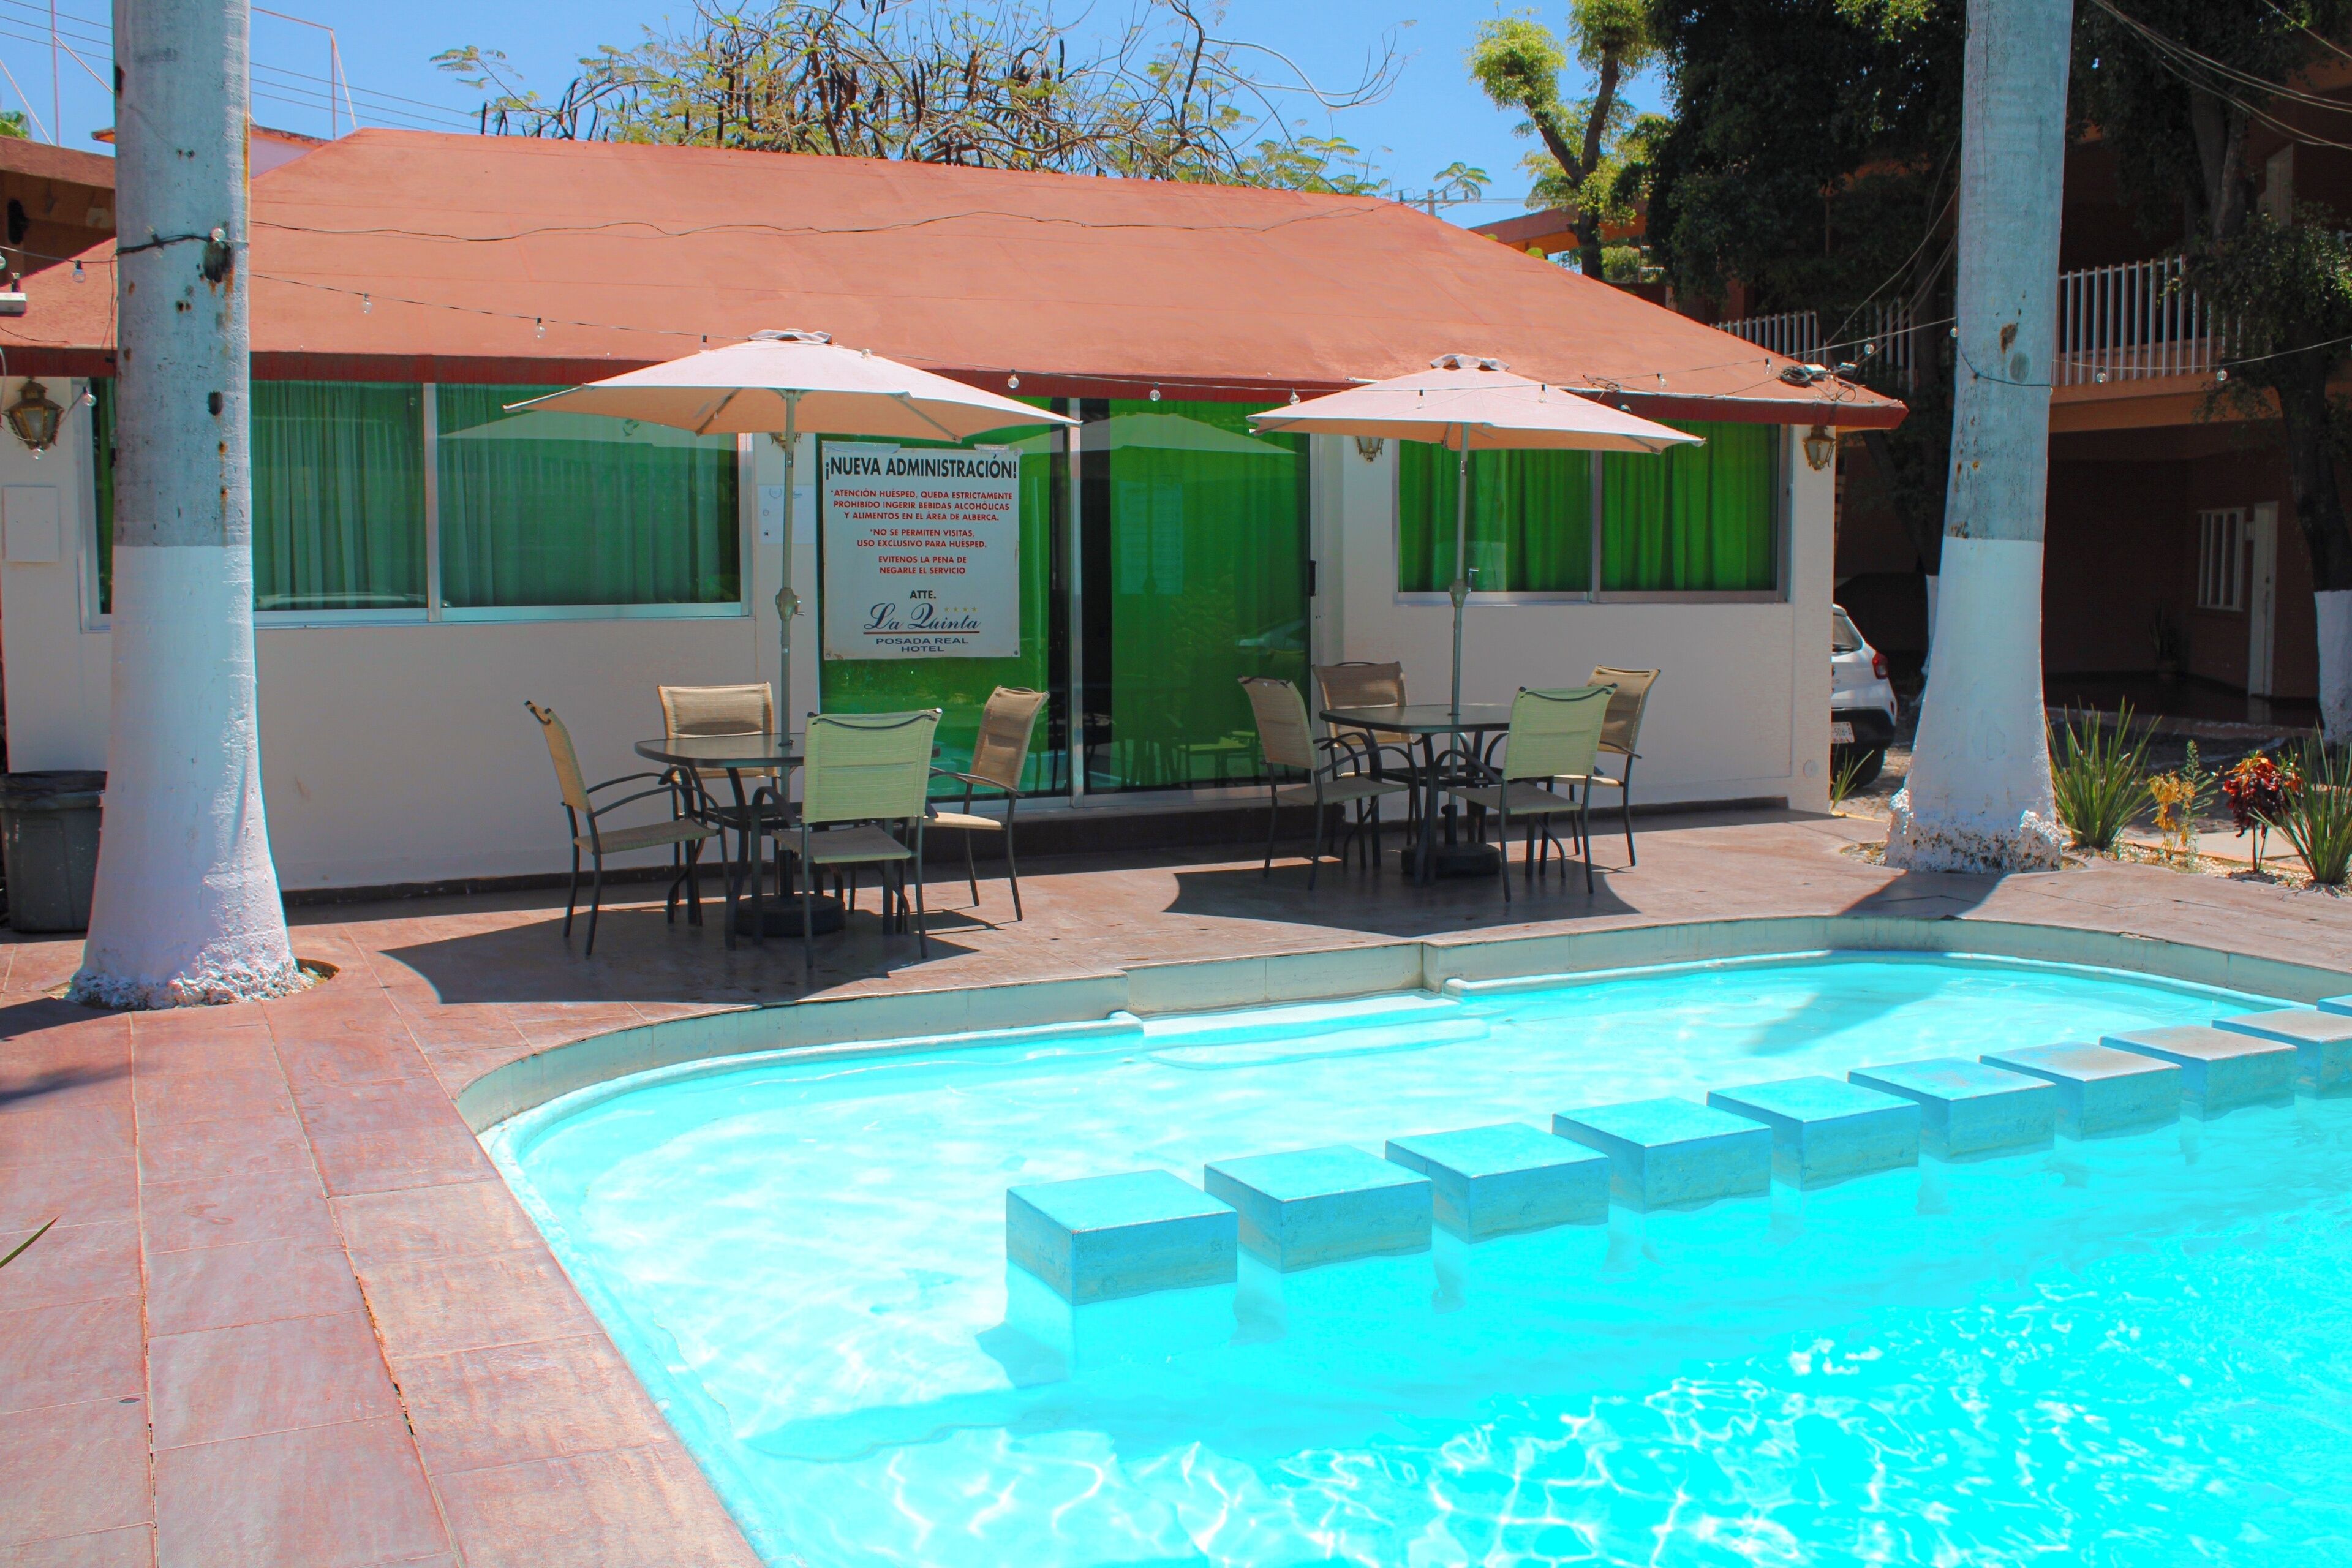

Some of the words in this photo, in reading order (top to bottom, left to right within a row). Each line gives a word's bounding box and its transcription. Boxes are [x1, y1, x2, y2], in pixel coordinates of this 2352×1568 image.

[826, 457, 881, 480] ¡NUEVA
[886, 454, 1017, 478] ADMINISTRACIÓN!
[880, 488, 918, 499] HUÉSPED,
[955, 501, 1009, 510] ALCOHÓLICAS
[926, 511, 947, 520] ÁREA
[949, 538, 987, 548] HUÉSPED.
[910, 590, 937, 599] ATTE.
[864, 603, 904, 630] La
[907, 603, 981, 630] Quinta
